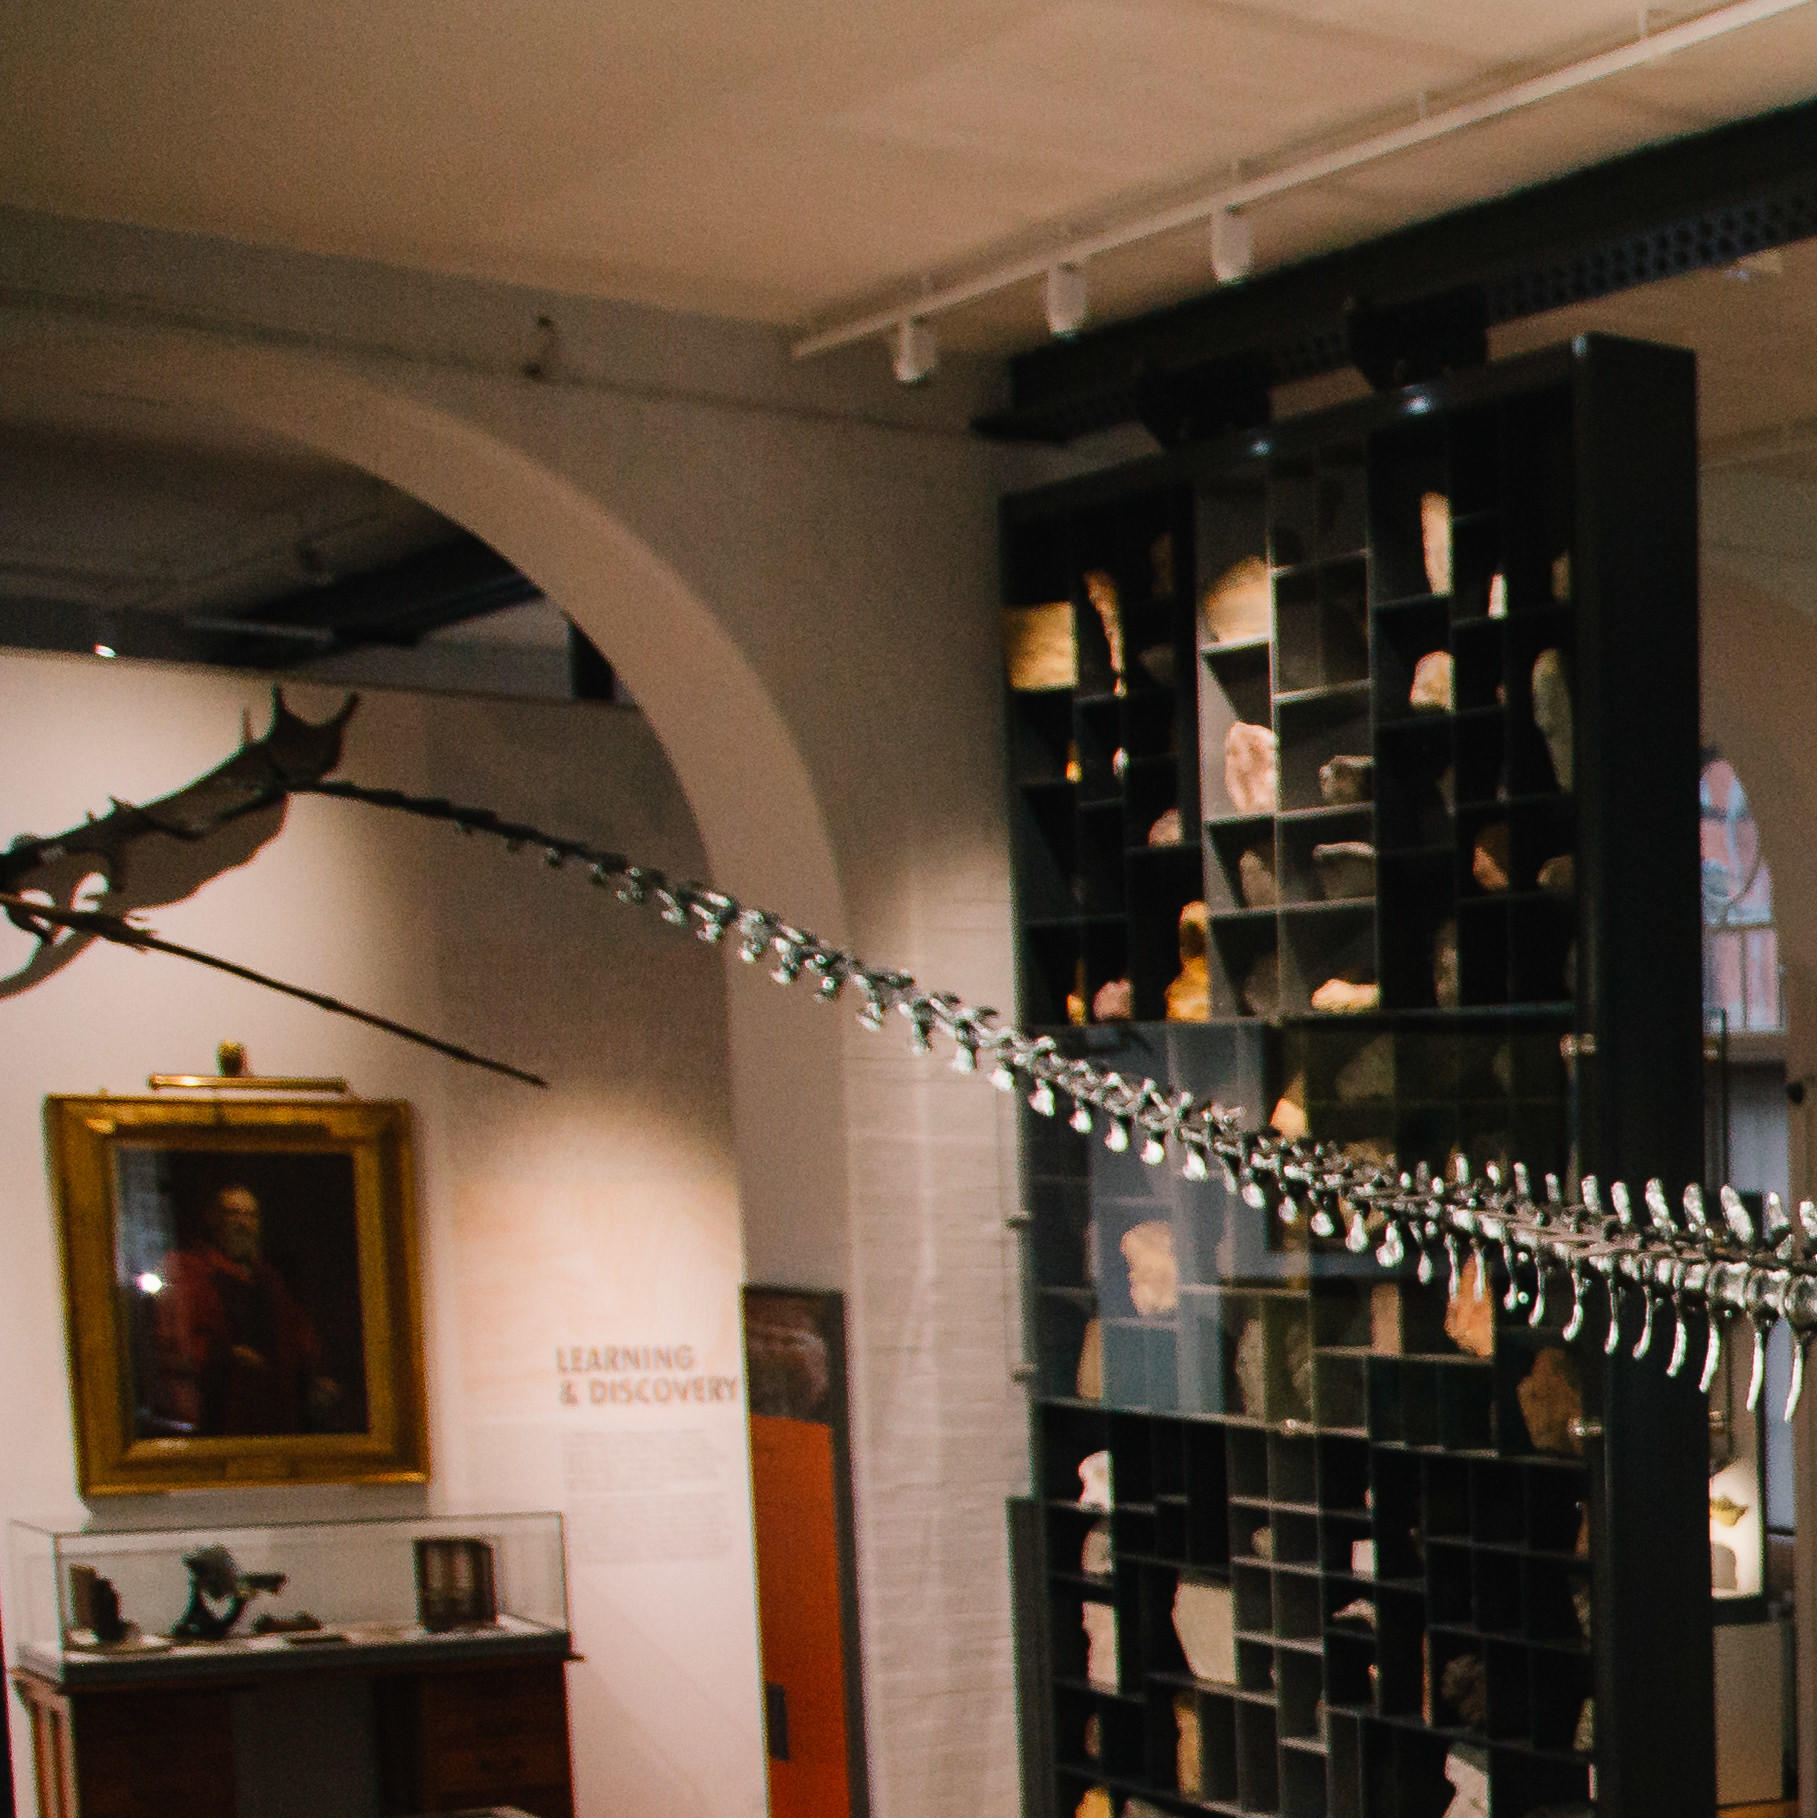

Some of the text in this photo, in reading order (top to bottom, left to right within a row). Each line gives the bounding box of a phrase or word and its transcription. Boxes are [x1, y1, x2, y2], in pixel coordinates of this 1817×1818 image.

[556, 1345, 695, 1372] LEARNING
[560, 1375, 740, 1405] & DISCOVERY
